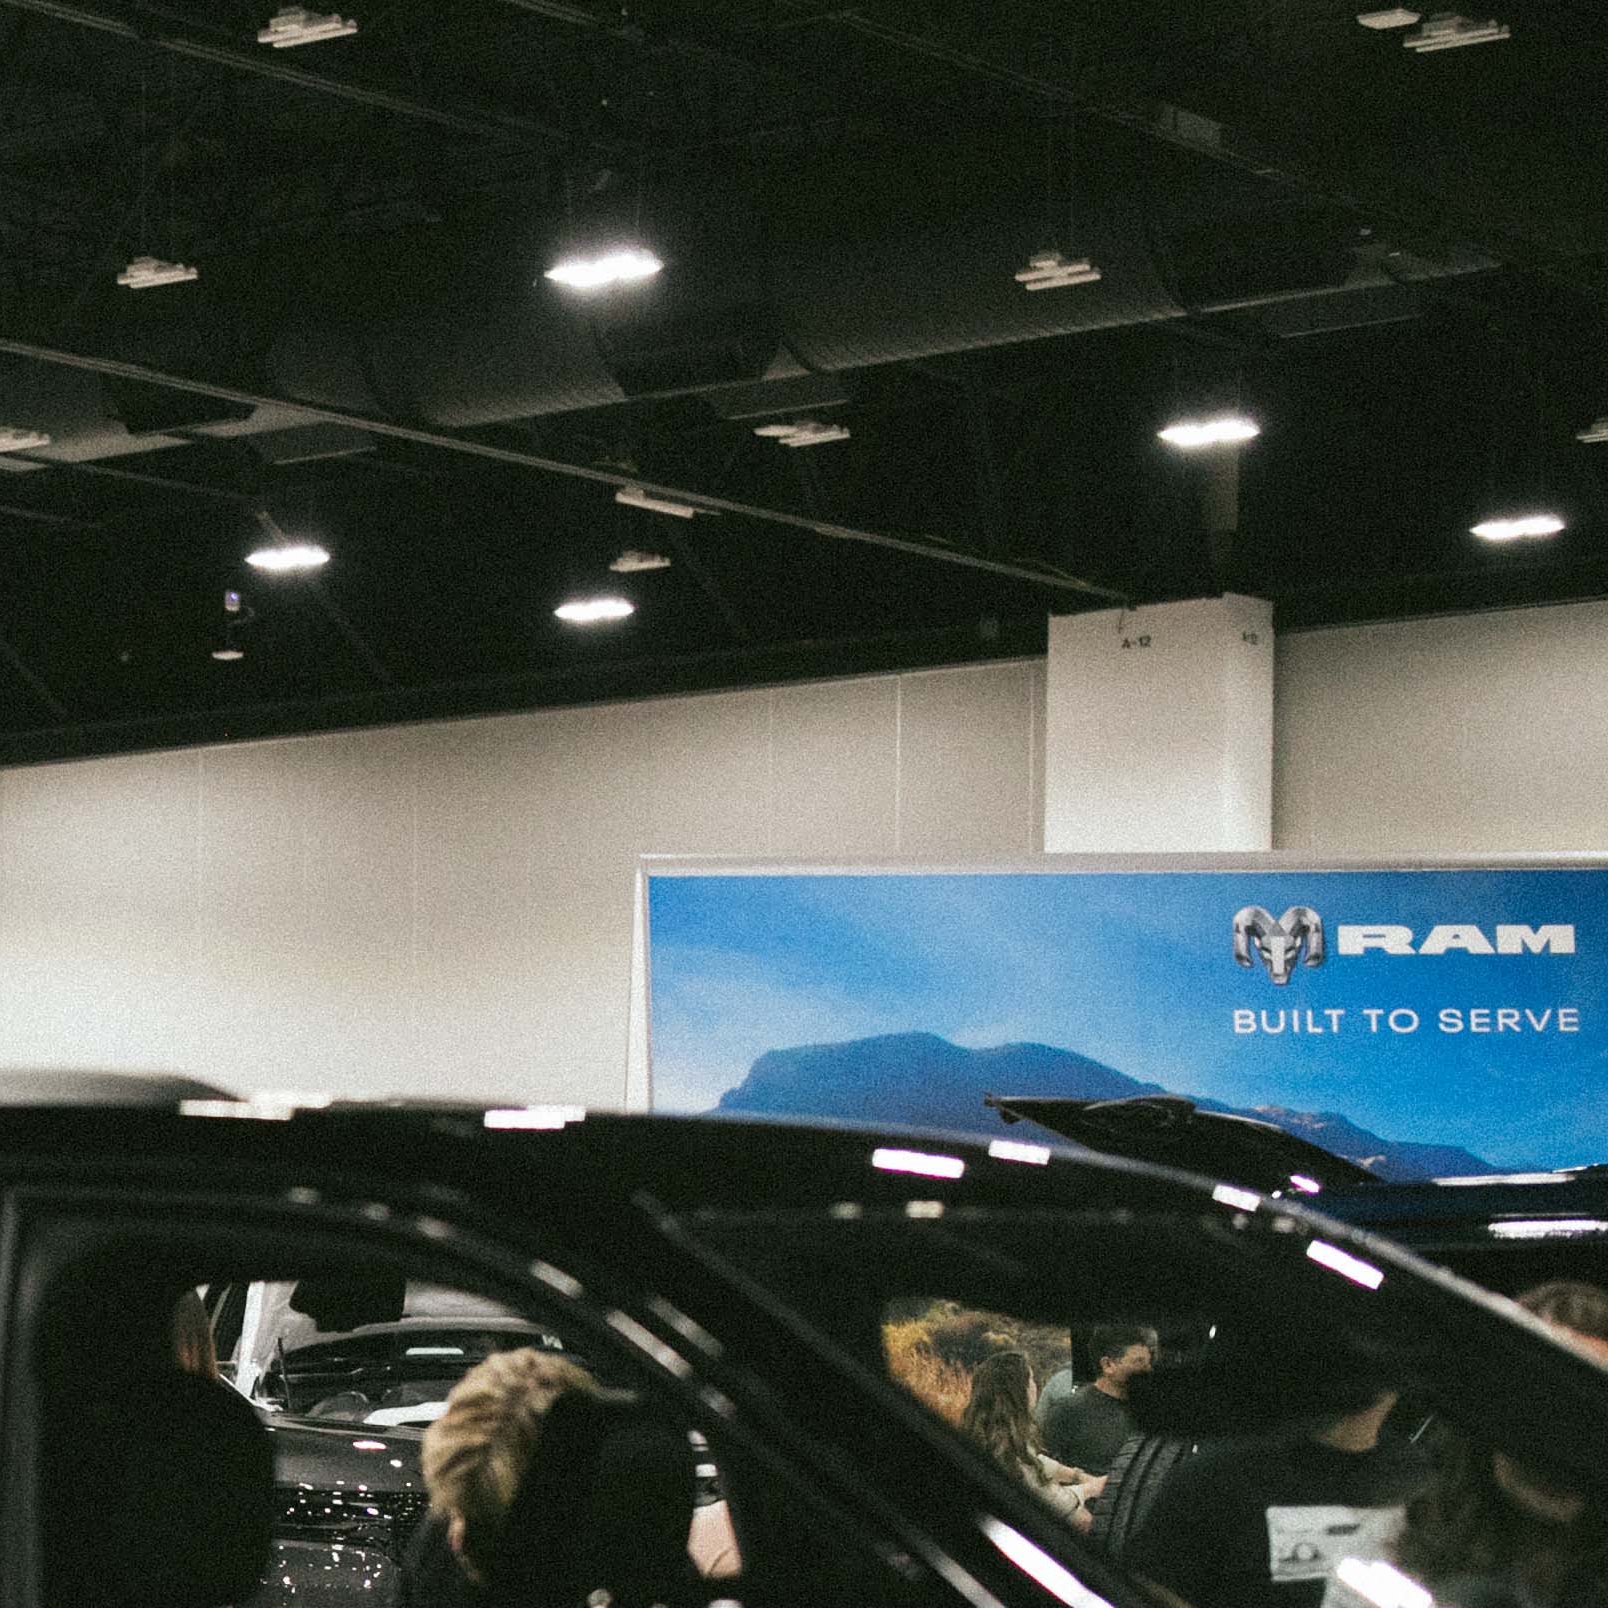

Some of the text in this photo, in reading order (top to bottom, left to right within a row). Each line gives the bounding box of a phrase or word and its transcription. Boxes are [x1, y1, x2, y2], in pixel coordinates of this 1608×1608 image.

[1337, 924, 1577, 955] RAM
[1232, 1007, 1581, 1034] BUILT TO SERVE
